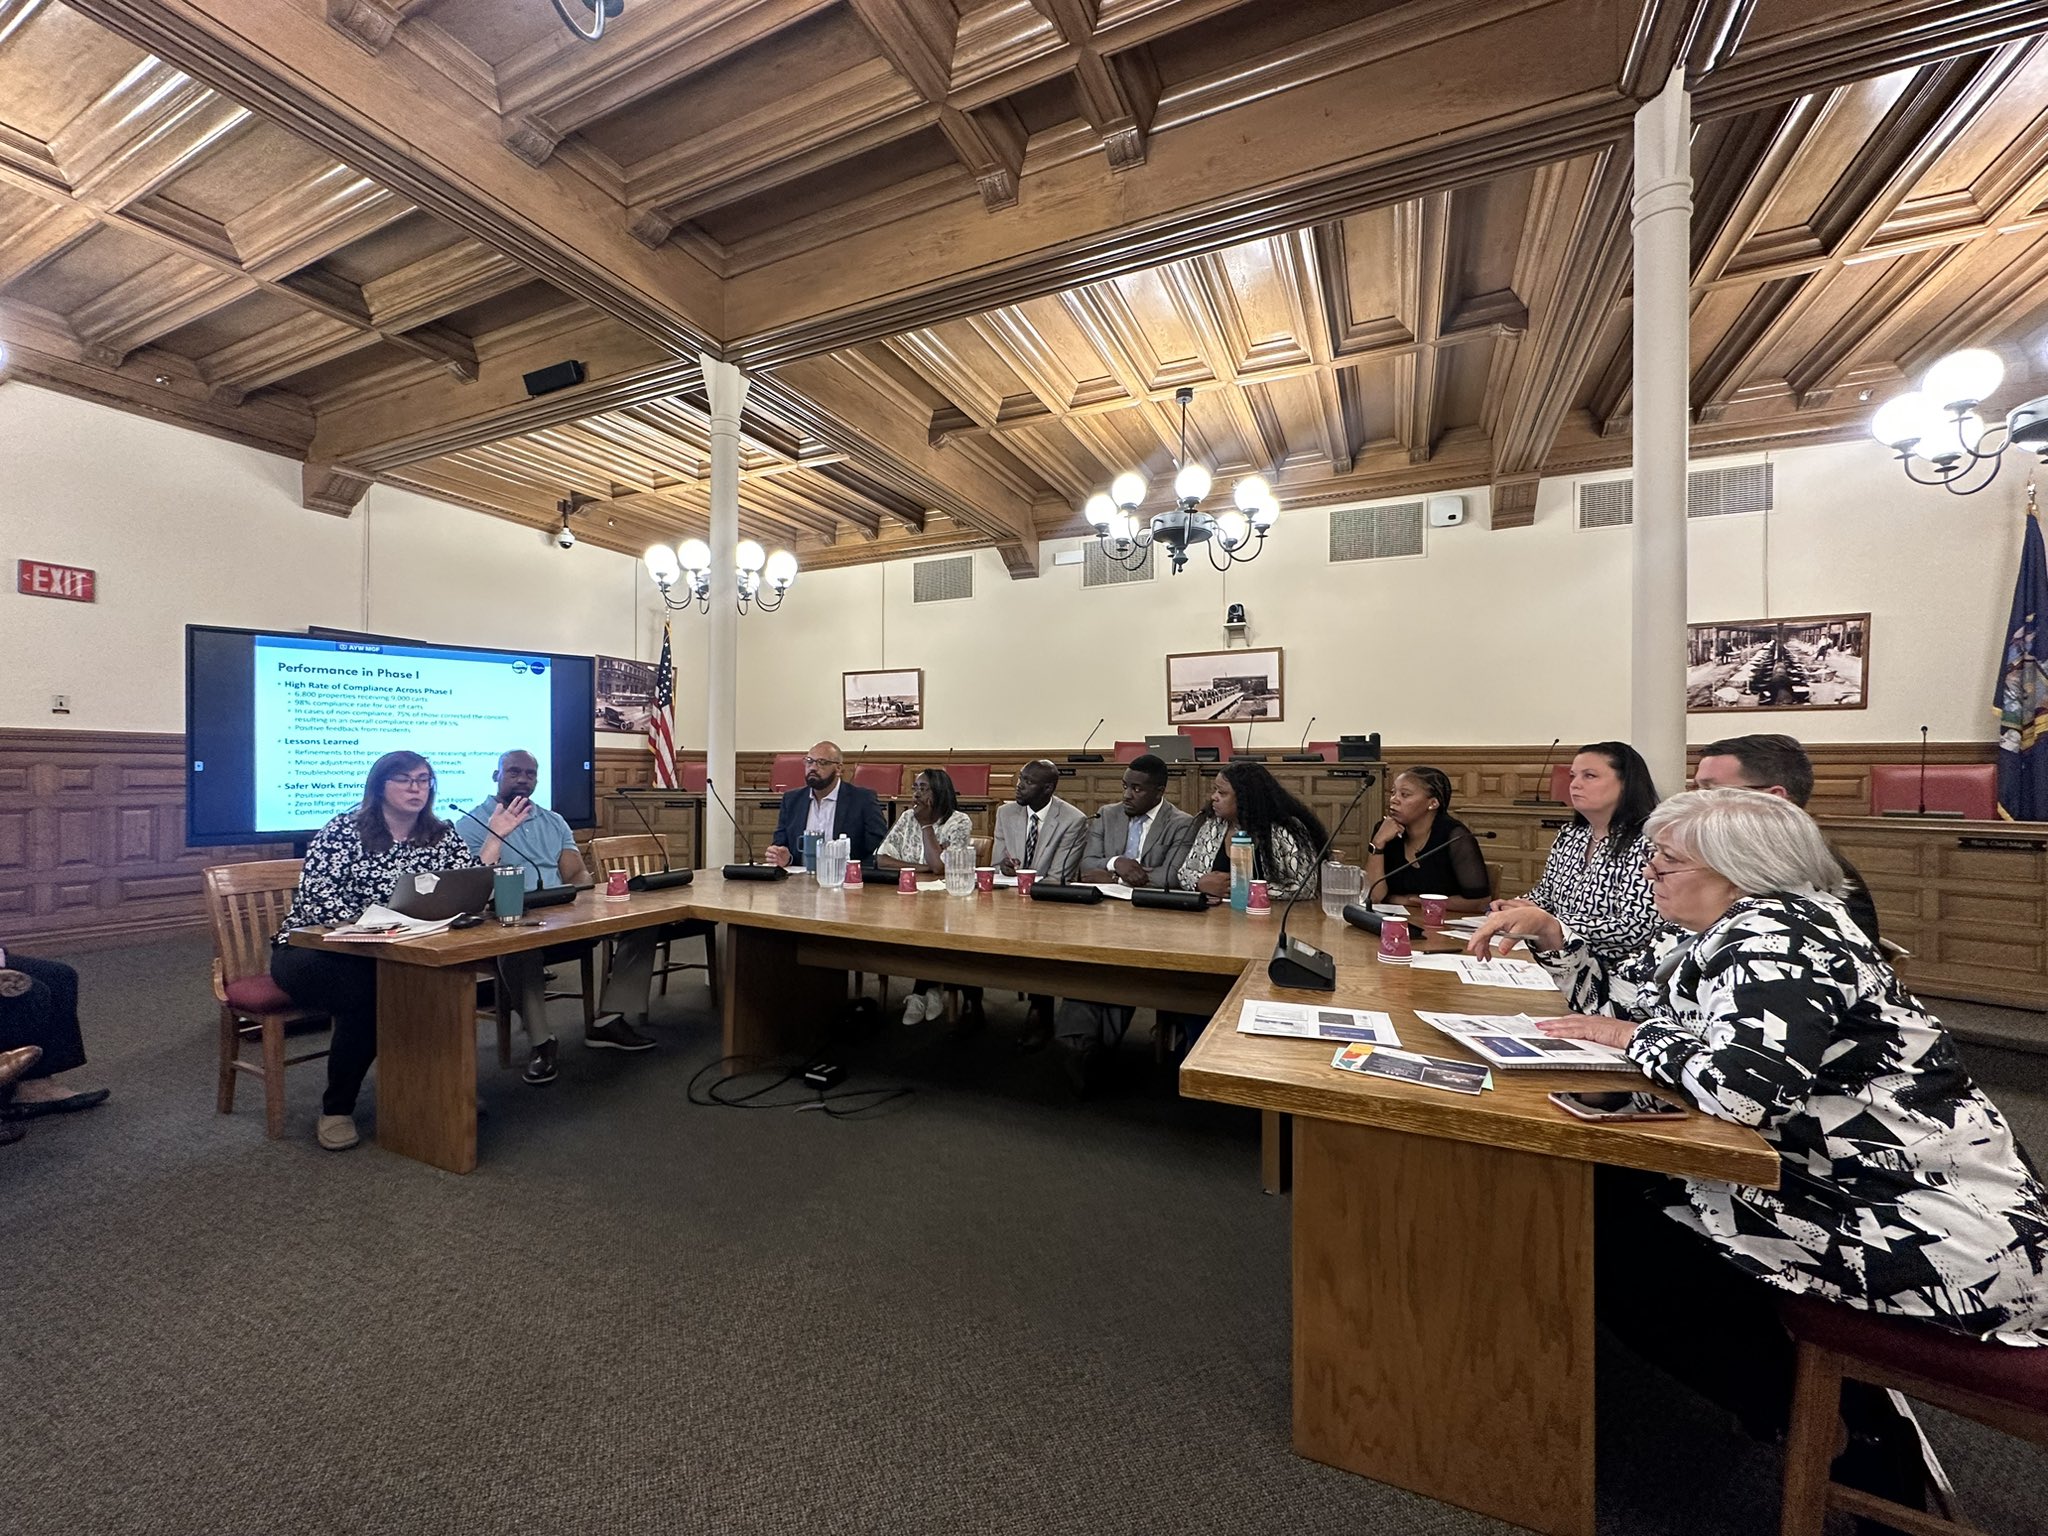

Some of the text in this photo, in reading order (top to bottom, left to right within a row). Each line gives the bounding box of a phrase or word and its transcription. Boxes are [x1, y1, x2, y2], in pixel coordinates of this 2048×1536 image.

[33, 565, 86, 597] EXIT
[278, 662, 420, 680] Performance in Phase I
[284, 681, 306, 690] High
[308, 682, 330, 690] Rate
[331, 683, 341, 691] of
[343, 683, 394, 693] Compliance
[395, 686, 423, 694] Across
[424, 687, 448, 695] Phase
[323, 738, 359, 746] Learned
[294, 769, 355, 777] Troubleshooting
[284, 782, 309, 790] Safer
[311, 782, 336, 790] Work
[294, 800, 313, 808] Zero
